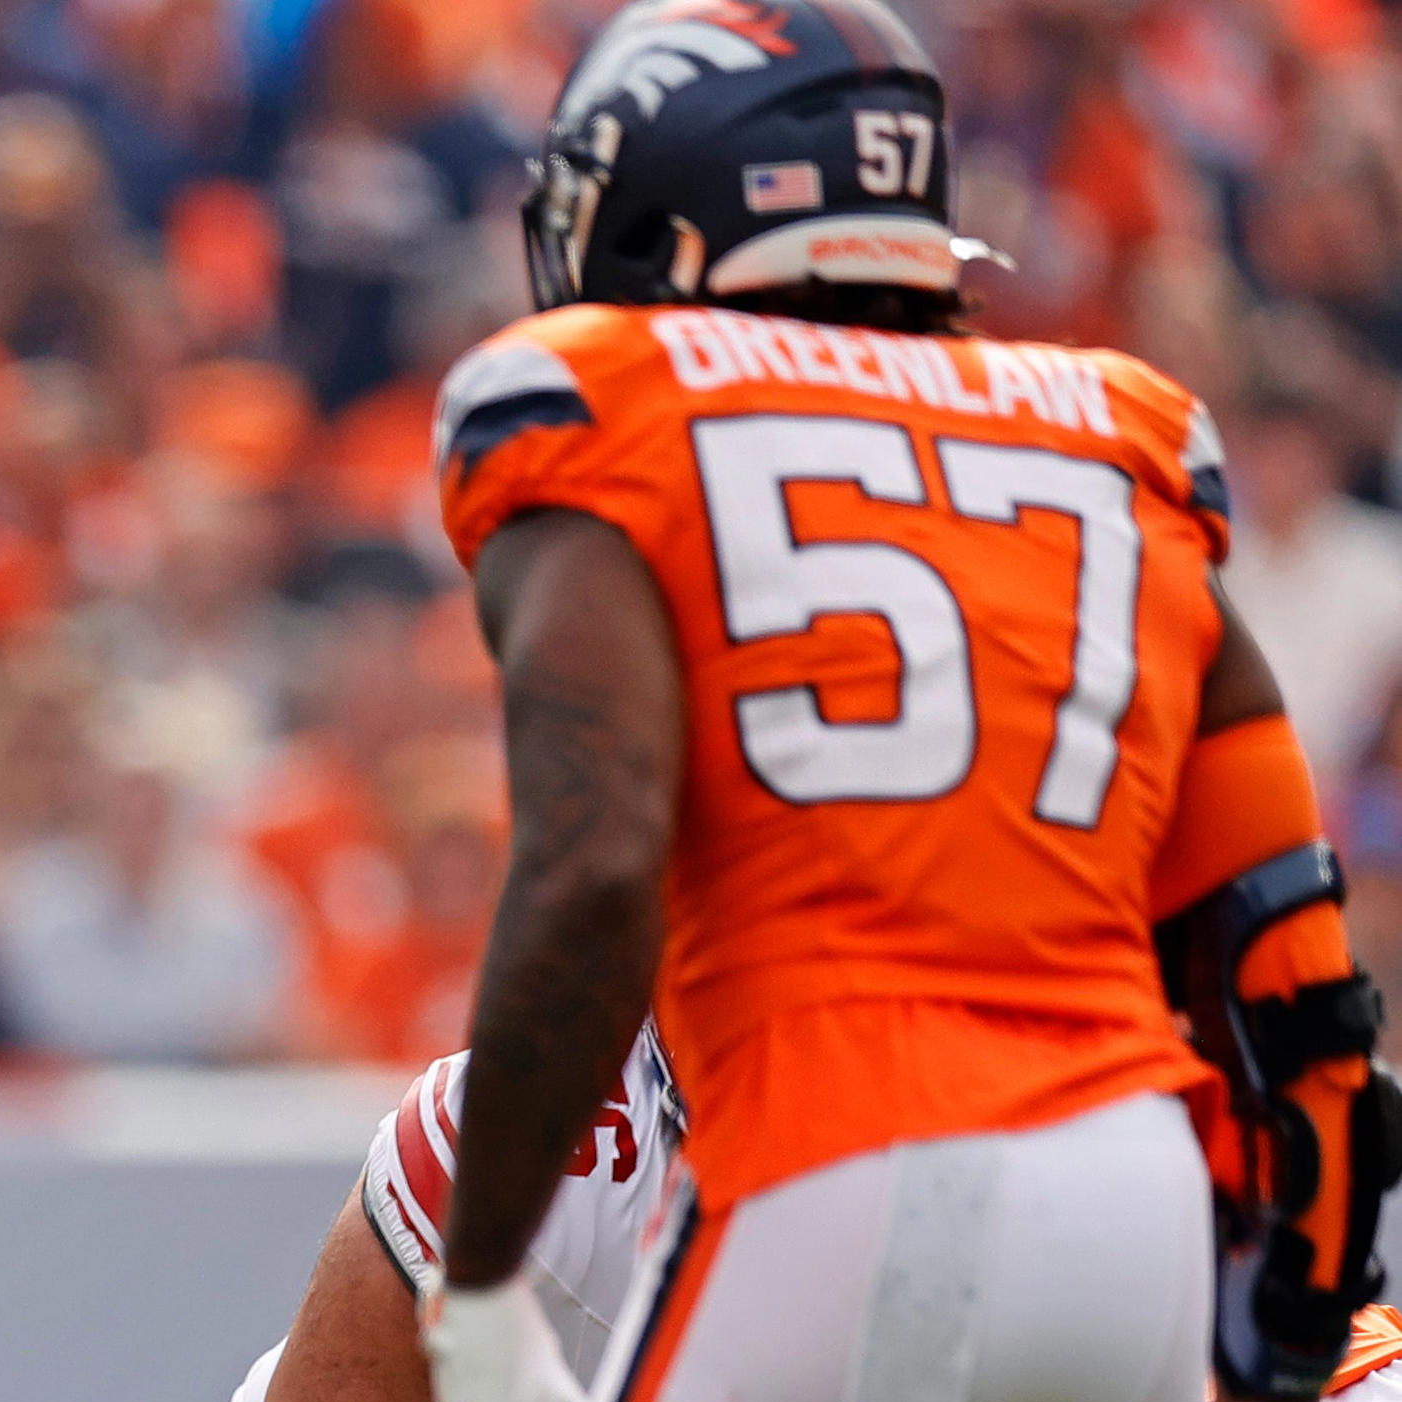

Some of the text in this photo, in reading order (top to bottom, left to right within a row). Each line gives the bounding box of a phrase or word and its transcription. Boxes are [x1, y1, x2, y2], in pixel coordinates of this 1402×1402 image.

[853, 110, 935, 198] 57
[649, 308, 1119, 437] GREENLAW
[689, 412, 1141, 829] 57
